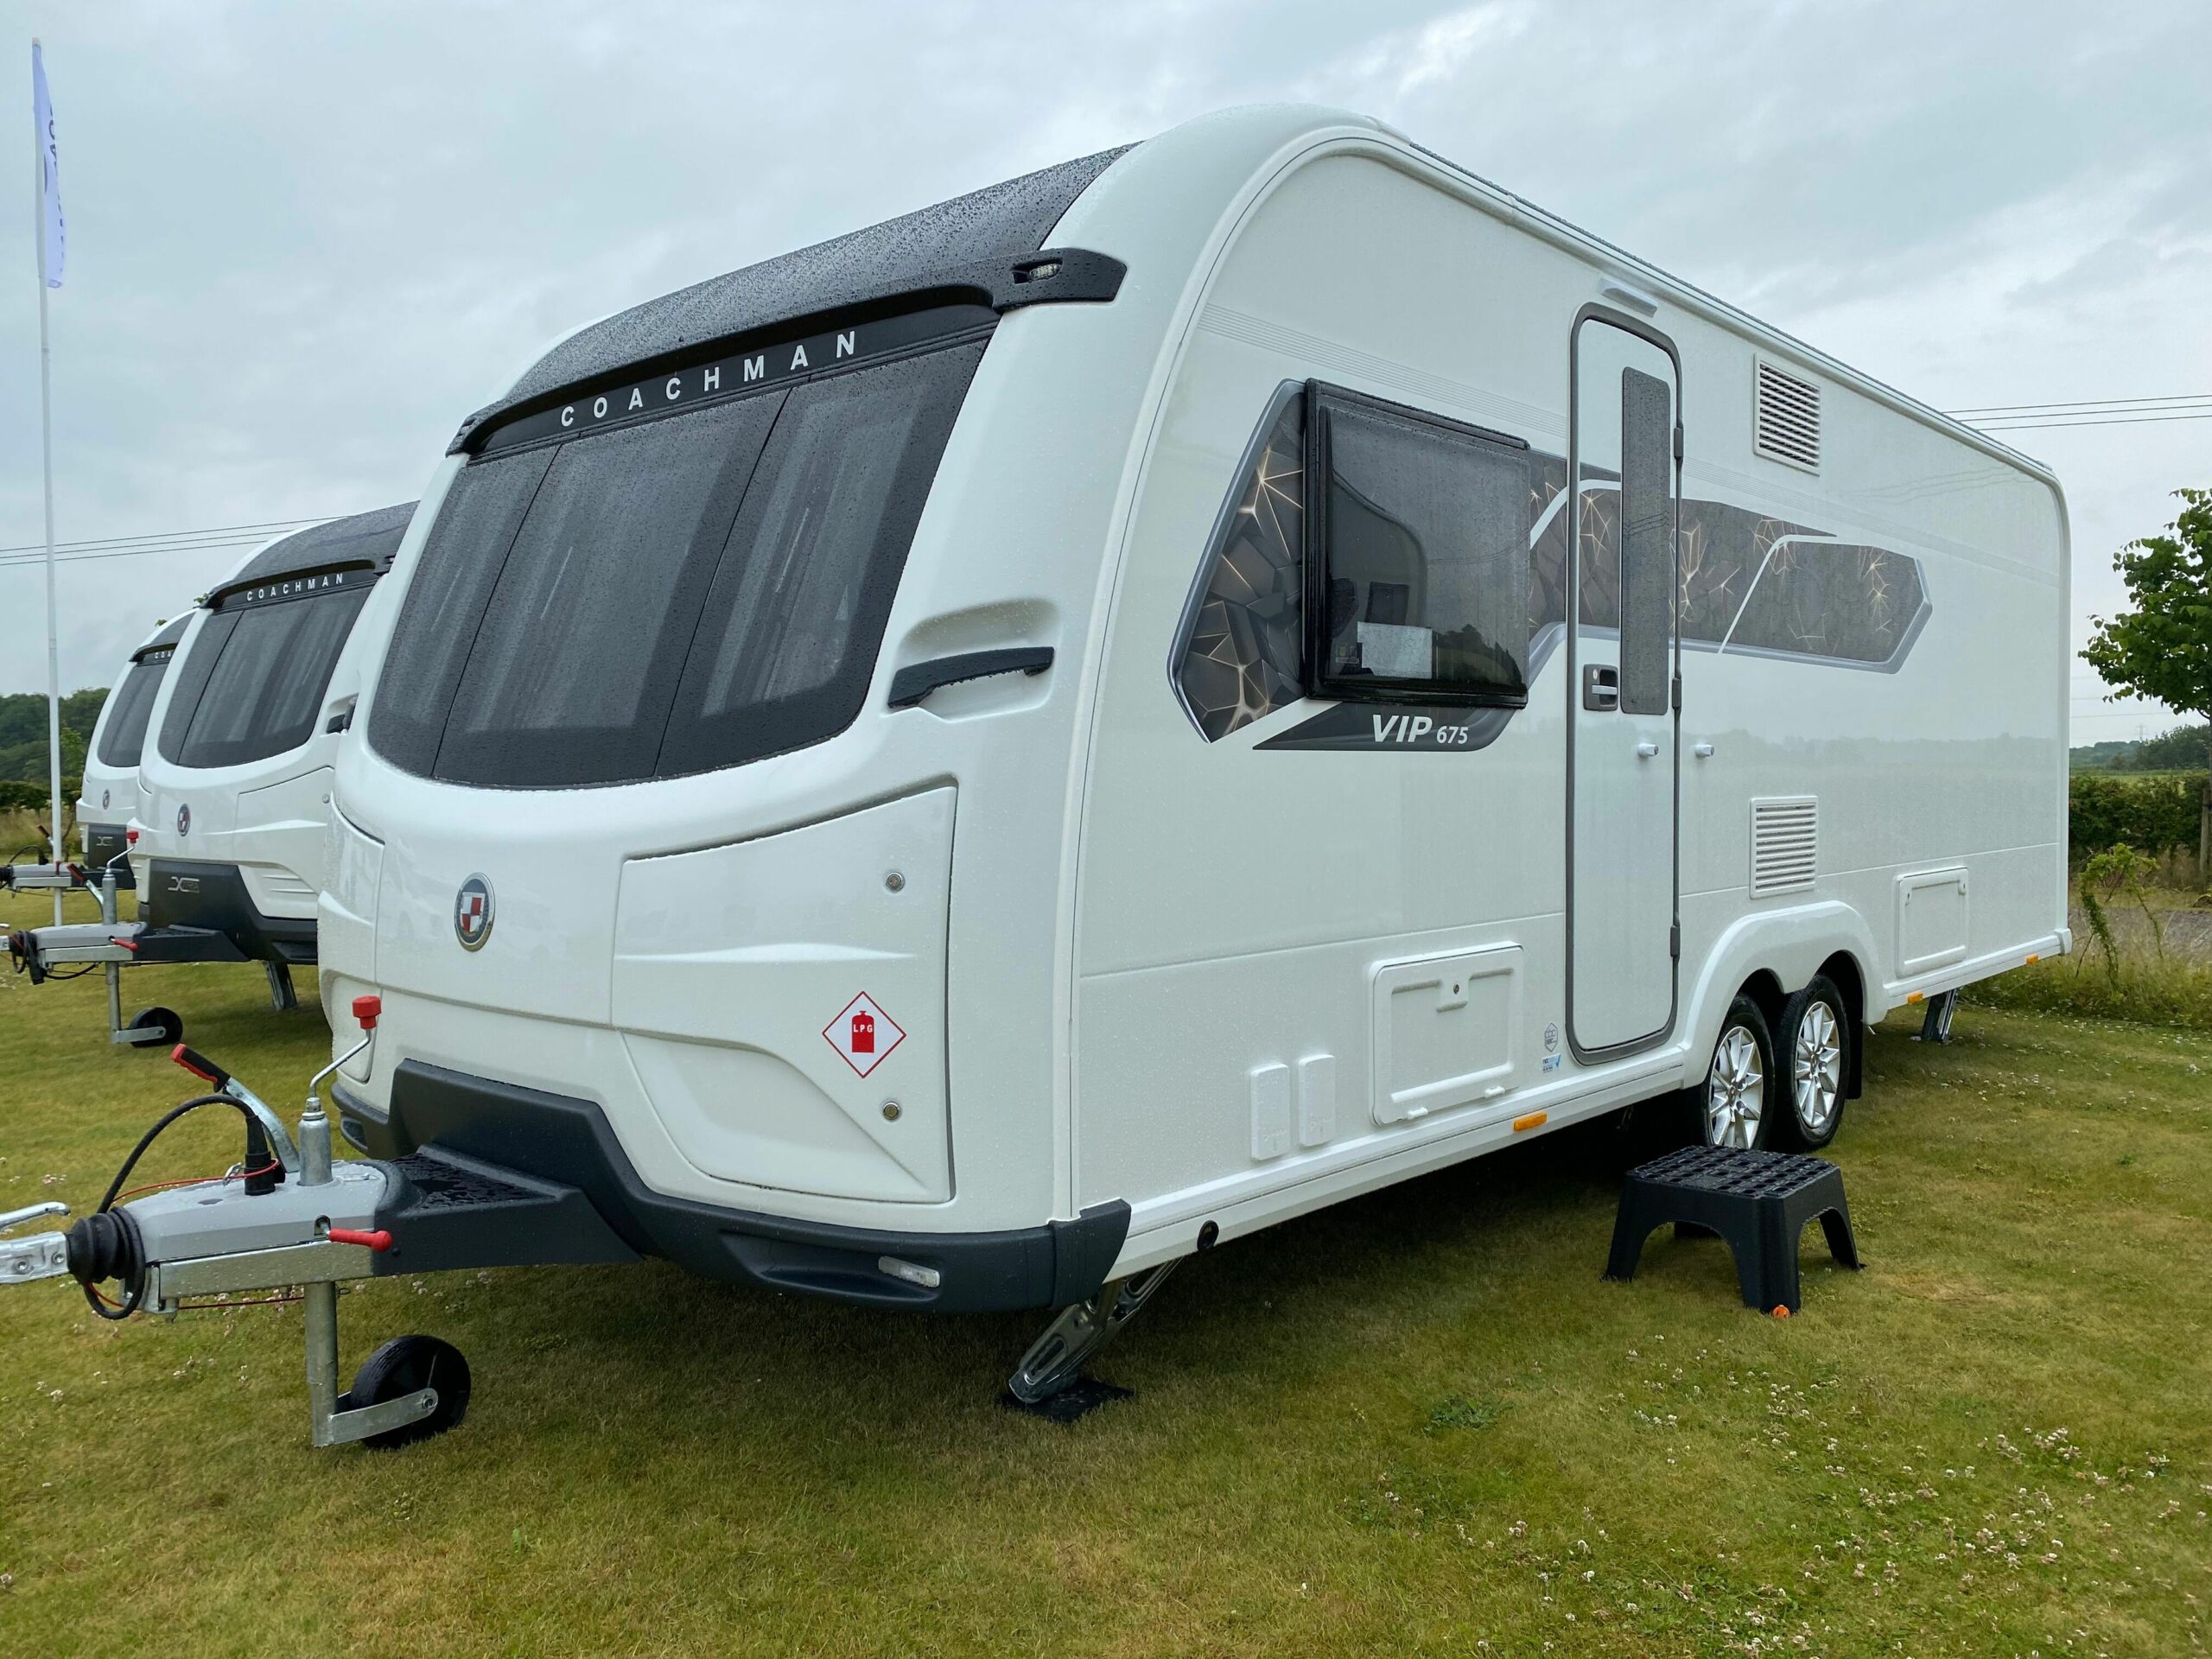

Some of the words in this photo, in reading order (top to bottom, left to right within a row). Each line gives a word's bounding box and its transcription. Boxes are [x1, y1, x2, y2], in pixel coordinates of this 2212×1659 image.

[561, 331, 855, 428] COACHMAN
[246, 573, 343, 601] COACHMAN
[1372, 714, 1433, 742] VIP
[1436, 725, 1469, 744] 675
[853, 1023, 874, 1033] LPG
